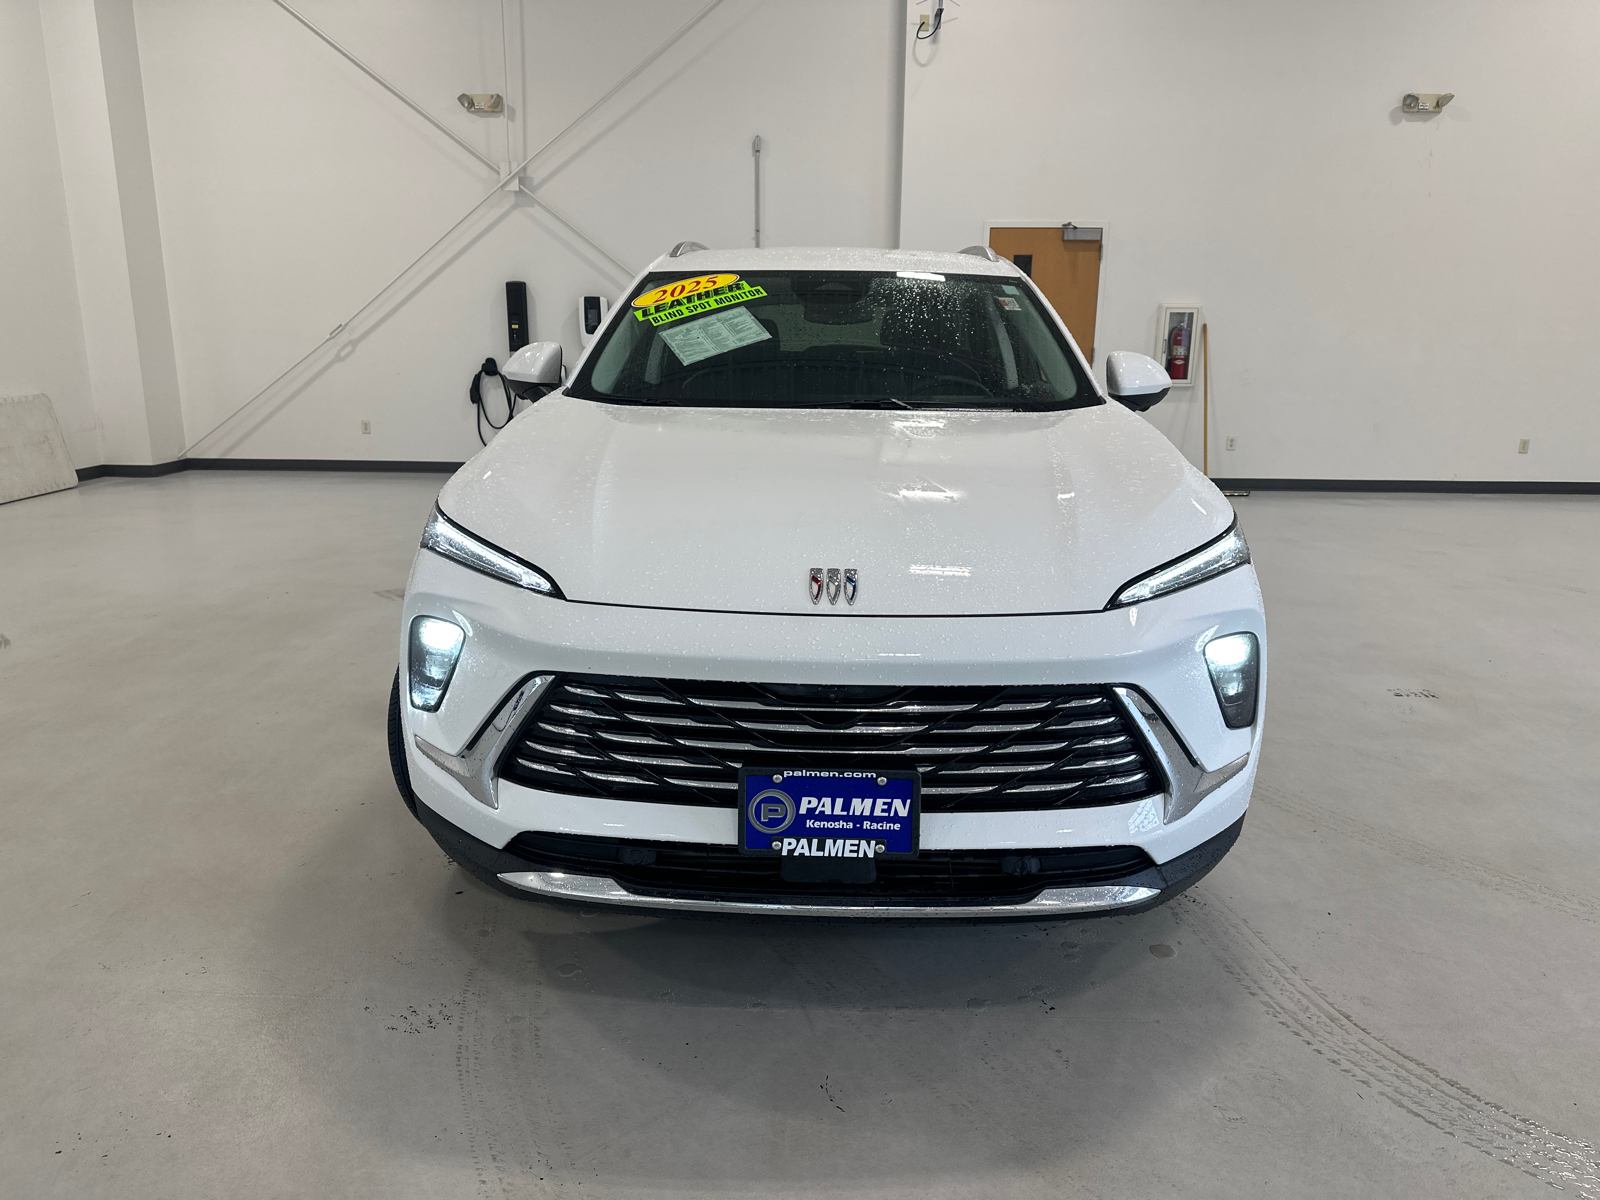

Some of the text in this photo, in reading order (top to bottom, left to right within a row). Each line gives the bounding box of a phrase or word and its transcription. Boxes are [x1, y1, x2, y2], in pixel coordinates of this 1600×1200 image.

[652, 275, 719, 304] 2025
[641, 283, 746, 318] LEATHER
[652, 288, 764, 324] BLIND SPOT MONITOR
[783, 770, 877, 779] palmen.com
[760, 803, 787, 822] P
[799, 796, 911, 817] PALMEN
[806, 819, 853, 829] Kenosha
[863, 820, 901, 831] Racine
[781, 838, 876, 858] PALMEN
